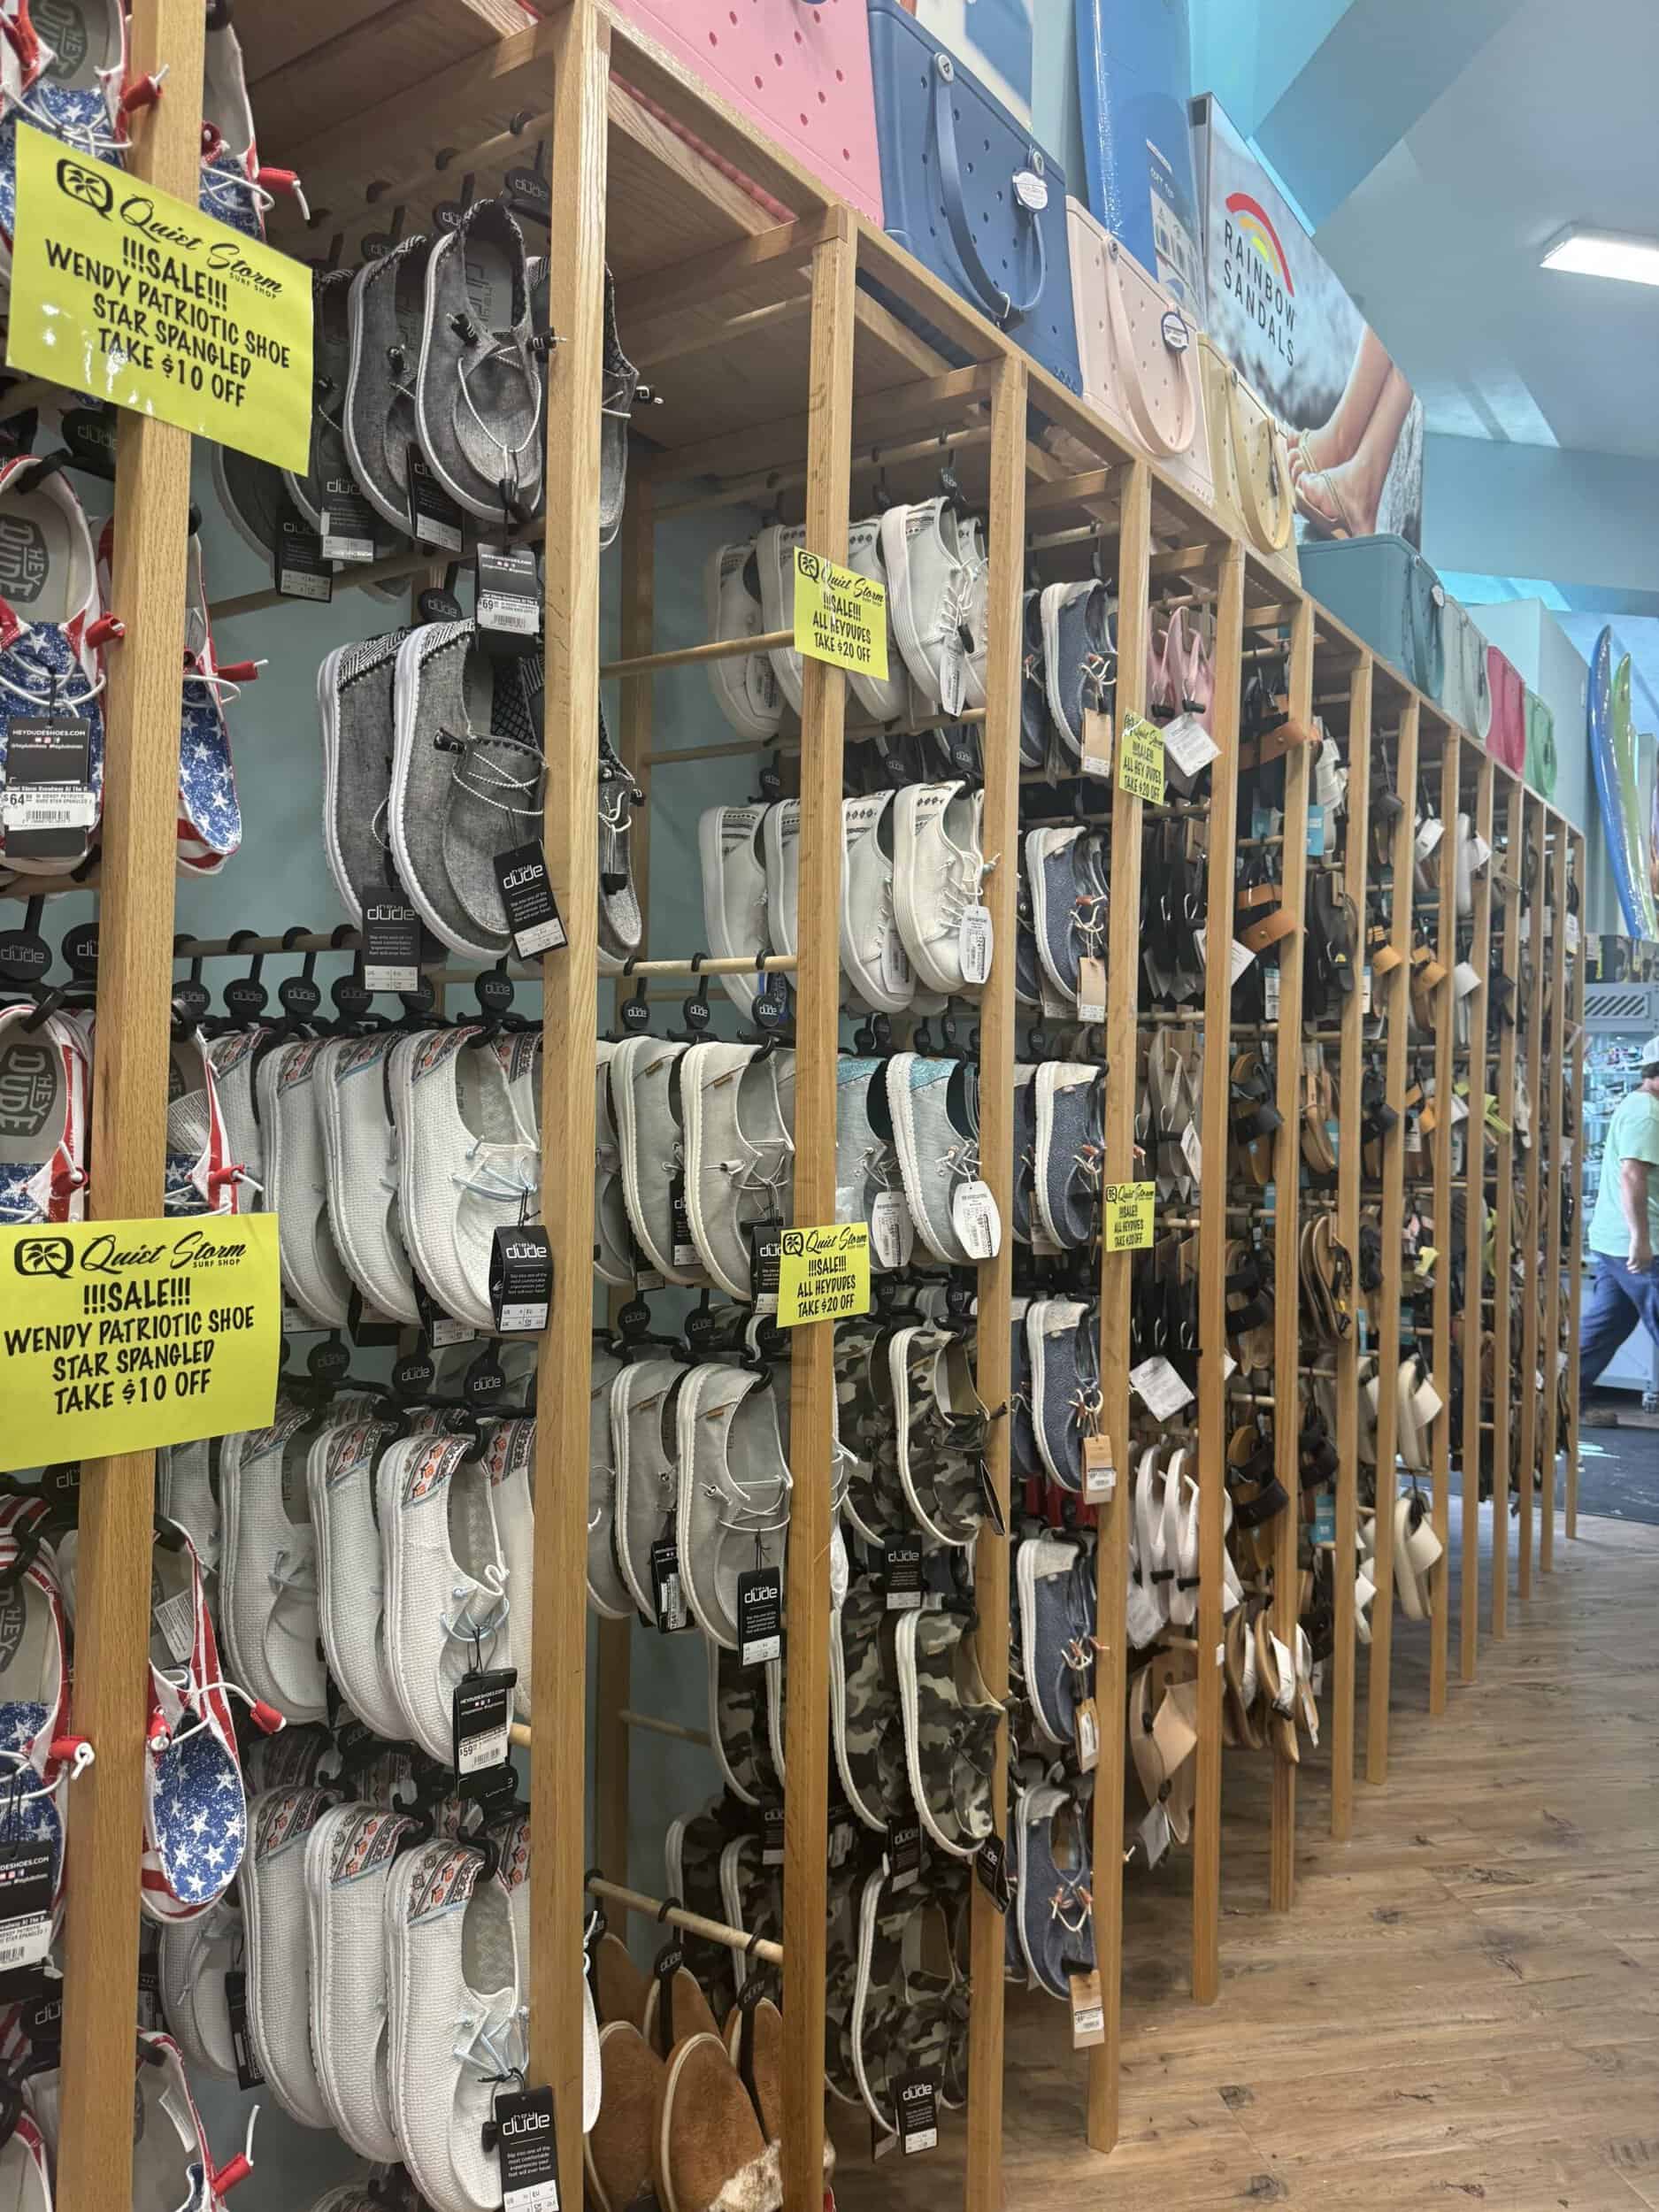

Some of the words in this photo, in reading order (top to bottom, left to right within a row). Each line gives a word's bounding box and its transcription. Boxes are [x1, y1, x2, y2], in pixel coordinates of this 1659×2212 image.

[120, 194, 203, 251] Quiet
[207, 242, 282, 294] Storm
[123, 237, 227, 311] !!!SALE!!!
[1224, 219, 1295, 332] RAINBOW
[45, 239, 130, 296] WENDY
[138, 280, 239, 345] PATRIOTIC
[245, 329, 290, 368] SHOE
[1224, 259, 1294, 366] SANDALS
[93, 293, 148, 338] STAR
[156, 321, 250, 378] SPANGLED
[98, 328, 153, 369] TAKE
[162, 353, 203, 392] $10
[211, 373, 247, 407] OFF
[27, 547, 44, 586] HEY
[821, 565, 851, 590] Quiet
[854, 578, 884, 602] Storm
[427, 599, 457, 618] dude
[812, 611, 827, 629] ALL
[830, 616, 872, 644] HEYDUDES
[814, 632, 835, 651] TAKE
[837, 639, 854, 658] $20
[856, 645, 871, 663] OFF
[4, 794, 25, 805] $64
[503, 864, 544, 889] dude
[367, 905, 416, 921] dude
[1, 944, 44, 964] dude
[486, 982, 511, 996] dude
[0, 1053, 45, 1131] DUDE
[35, 1074, 53, 1117] HEY
[81, 1234, 166, 1274] Quiet
[170, 1231, 246, 1270] Storm
[506, 1244, 547, 1259] dude
[806, 1229, 838, 1255] Quiet
[839, 1226, 867, 1251] Storm
[193, 1260, 214, 1269] SURF
[218, 1258, 241, 1267] SHOP
[809, 1256, 847, 1277] !!!SALE!!!
[83, 1277, 191, 1315] !!!SALE!!!
[797, 1280, 813, 1298] ALL
[815, 1274, 856, 1295] HEYDUDES
[798, 1299, 820, 1317] TAKE
[821, 1296, 839, 1313] $20
[841, 1294, 855, 1310] OFF
[4, 1322, 92, 1356] WENDY
[99, 1312, 202, 1345] PATRIOTIC
[208, 1306, 255, 1333] SHOE
[52, 1351, 110, 1381] STAR
[116, 1339, 215, 1374] SPANGLED
[402, 1366, 431, 1381] dude
[54, 1381, 115, 1415] TAKE
[122, 1376, 166, 1404] $10
[176, 1369, 211, 1396] OFF
[473, 1376, 502, 1392] dude
[744, 1586, 778, 1604] dude
[4, 1607, 21, 1651] HEY
[459, 1745, 473, 1757] $59
[902, 2082, 932, 2101] dude
[503, 2112, 550, 2136] dude
